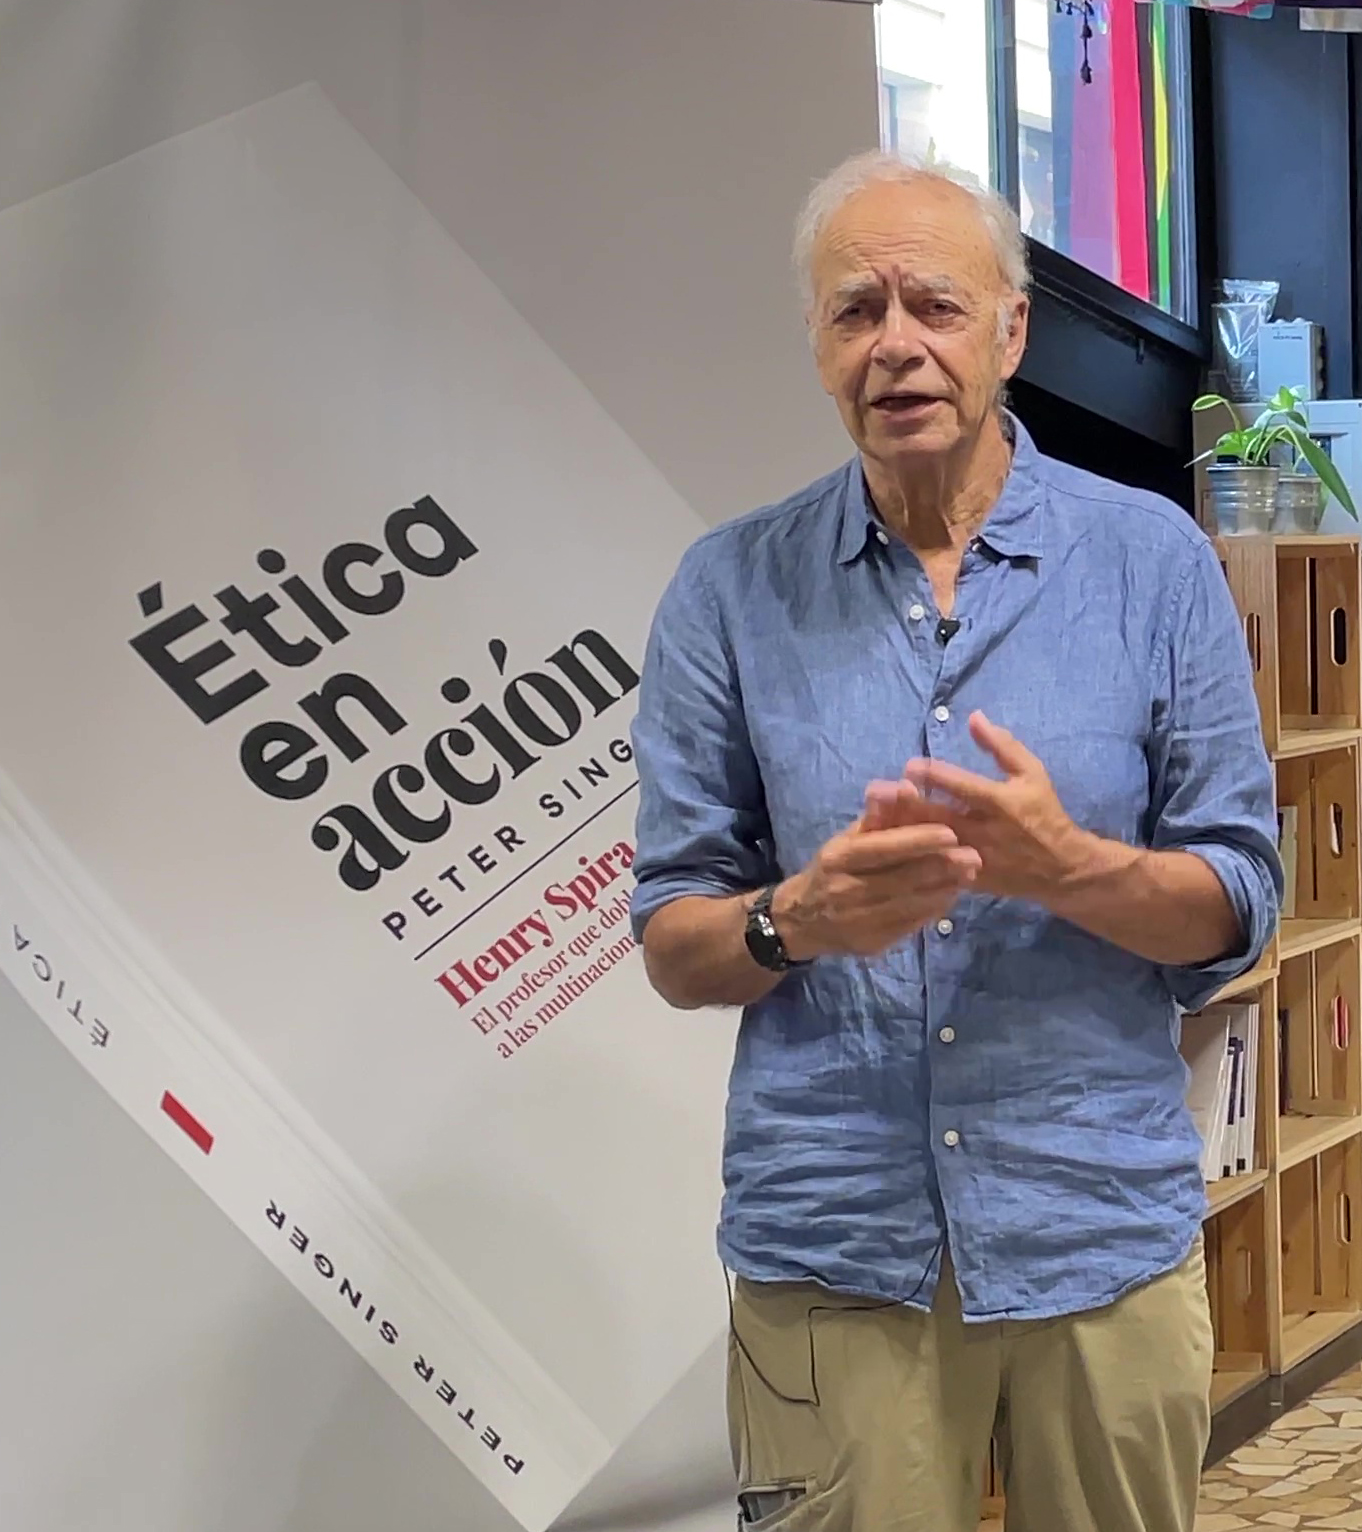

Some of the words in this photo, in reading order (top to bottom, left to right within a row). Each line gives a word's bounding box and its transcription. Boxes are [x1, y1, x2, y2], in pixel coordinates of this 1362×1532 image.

[128, 494, 480, 725] Ética
[239, 671, 408, 800] en
[311, 627, 640, 892] acción
[382, 825, 527, 940] PETER
[538, 738, 633, 818] SING
[13, 924, 110, 1048] ÉTICA
[434, 909, 555, 1010] Henry
[543, 841, 635, 922] Spira
[470, 1006, 499, 1035] El
[495, 949, 571, 1022] profesor
[567, 924, 602, 957] que
[599, 889, 632, 929] dobl
[534, 932, 636, 1027] multinacion
[497, 1042, 513, 1059] a
[504, 1018, 539, 1049] las
[264, 1199, 399, 1345] SINGER
[412, 1354, 525, 1475] PETER
